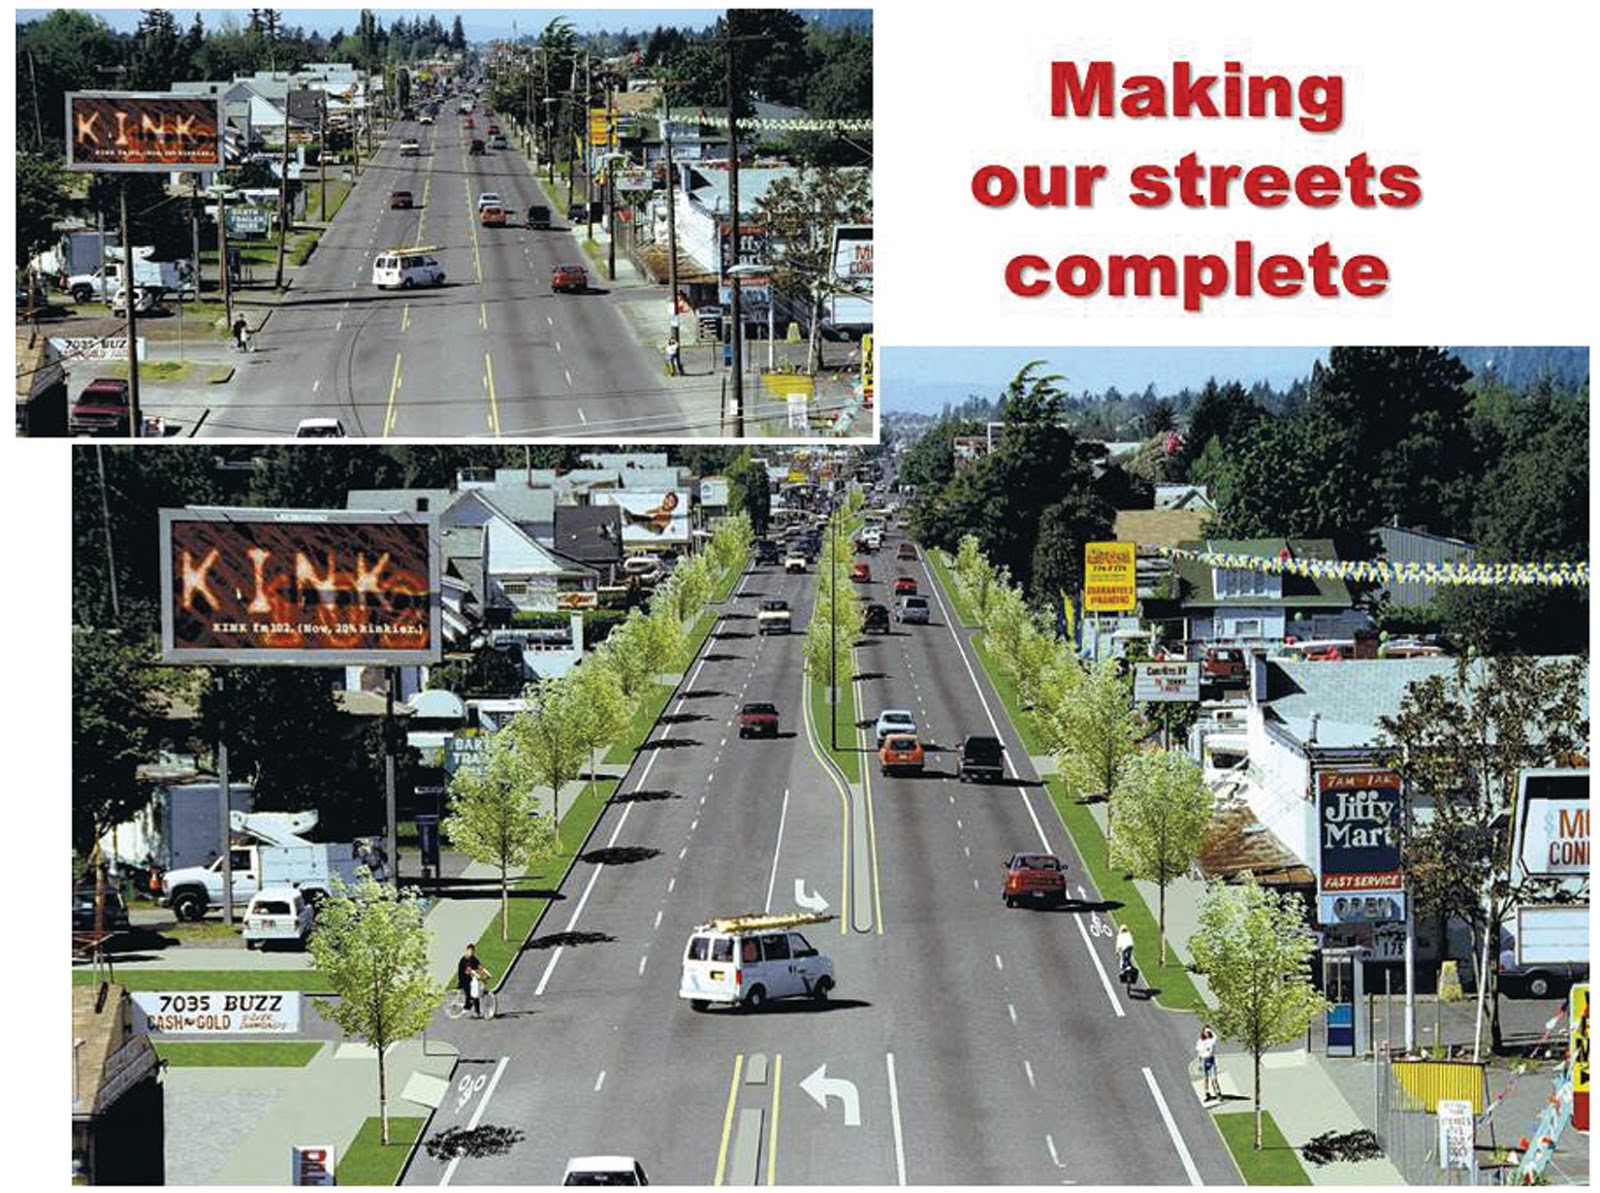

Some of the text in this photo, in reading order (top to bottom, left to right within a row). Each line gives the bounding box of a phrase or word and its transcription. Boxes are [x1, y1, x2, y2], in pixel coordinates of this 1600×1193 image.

[78, 111, 197, 145] KINK
[183, 548, 392, 613] KINK
[212, 623, 247, 633] KINK
[1325, 790, 1395, 825] Jiffy
[1324, 823, 1393, 849] Mart
[1324, 874, 1399, 889] FAST SERVICE
[1334, 896, 1393, 919] OPEN
[159, 994, 284, 1012] 7035 BUZZ
